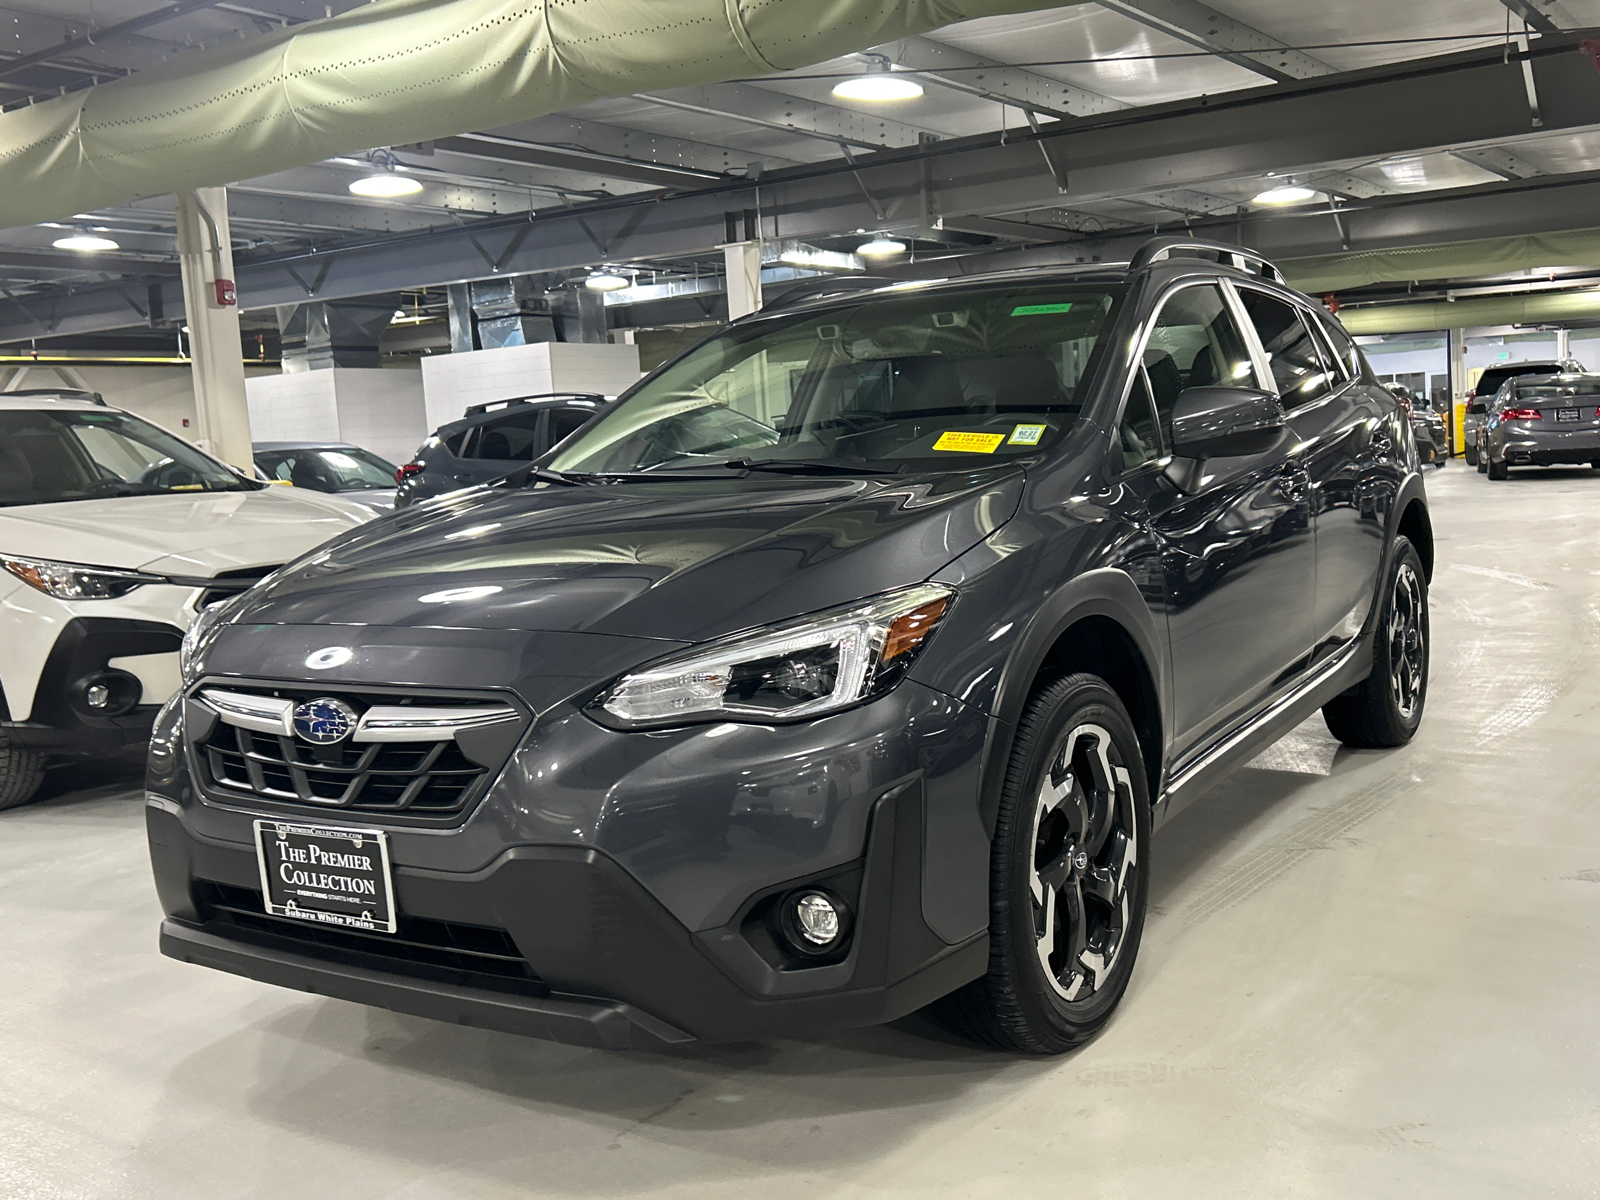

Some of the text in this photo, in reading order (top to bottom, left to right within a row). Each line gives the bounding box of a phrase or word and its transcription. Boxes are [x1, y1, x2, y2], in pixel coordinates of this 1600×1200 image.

[275, 841, 373, 871] THE PREMIER
[279, 862, 376, 895] COLLECTION
[284, 908, 375, 929] Subaru White Plains
